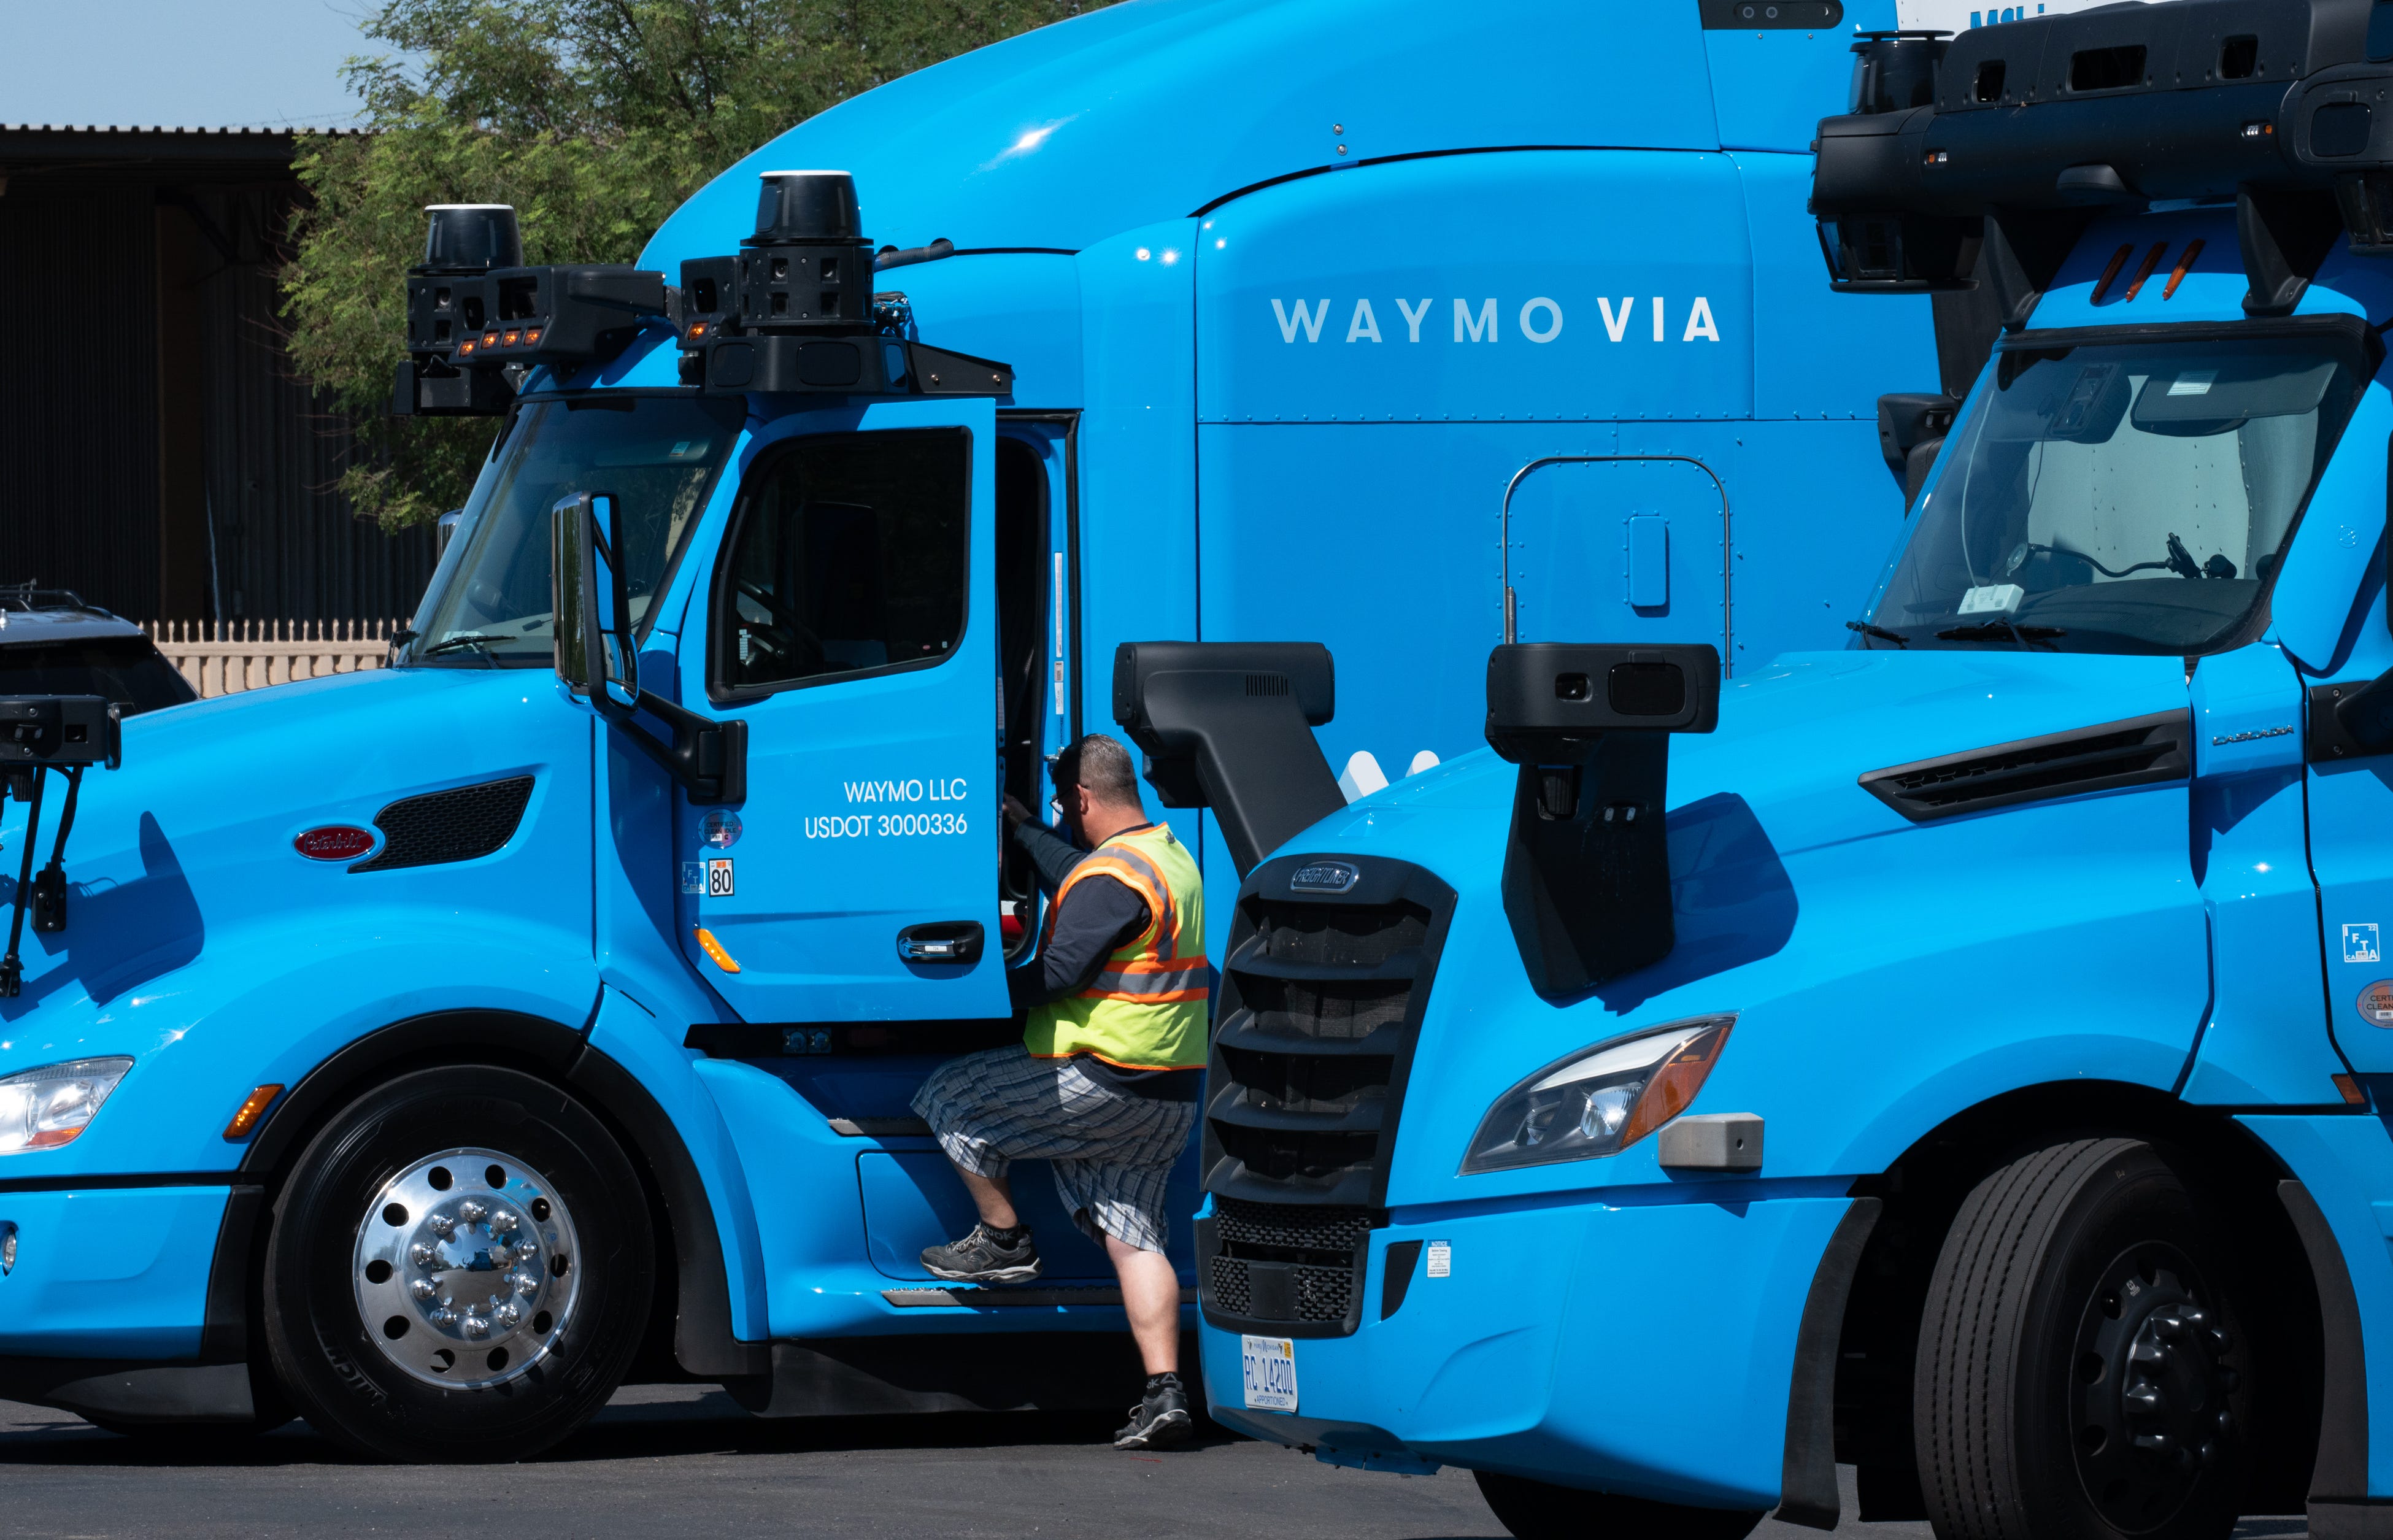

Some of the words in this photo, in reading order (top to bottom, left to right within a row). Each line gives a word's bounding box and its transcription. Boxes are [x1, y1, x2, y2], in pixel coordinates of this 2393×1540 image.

[1271, 296, 1563, 344] WAYMO
[1597, 296, 1721, 342] VIA
[844, 779, 923, 803] WAYMO
[930, 778, 967, 801] LLC
[805, 815, 873, 839] USDOT
[878, 813, 968, 837] 3000336
[304, 833, 367, 853] Peterbilt
[711, 869, 731, 893] 80
[1295, 867, 1350, 884] FREIGHTLINER
[1244, 1355, 1258, 1391] RC
[1262, 1357, 1293, 1395] 14200
[1256, 1395, 1285, 1406] APPORTIONED
